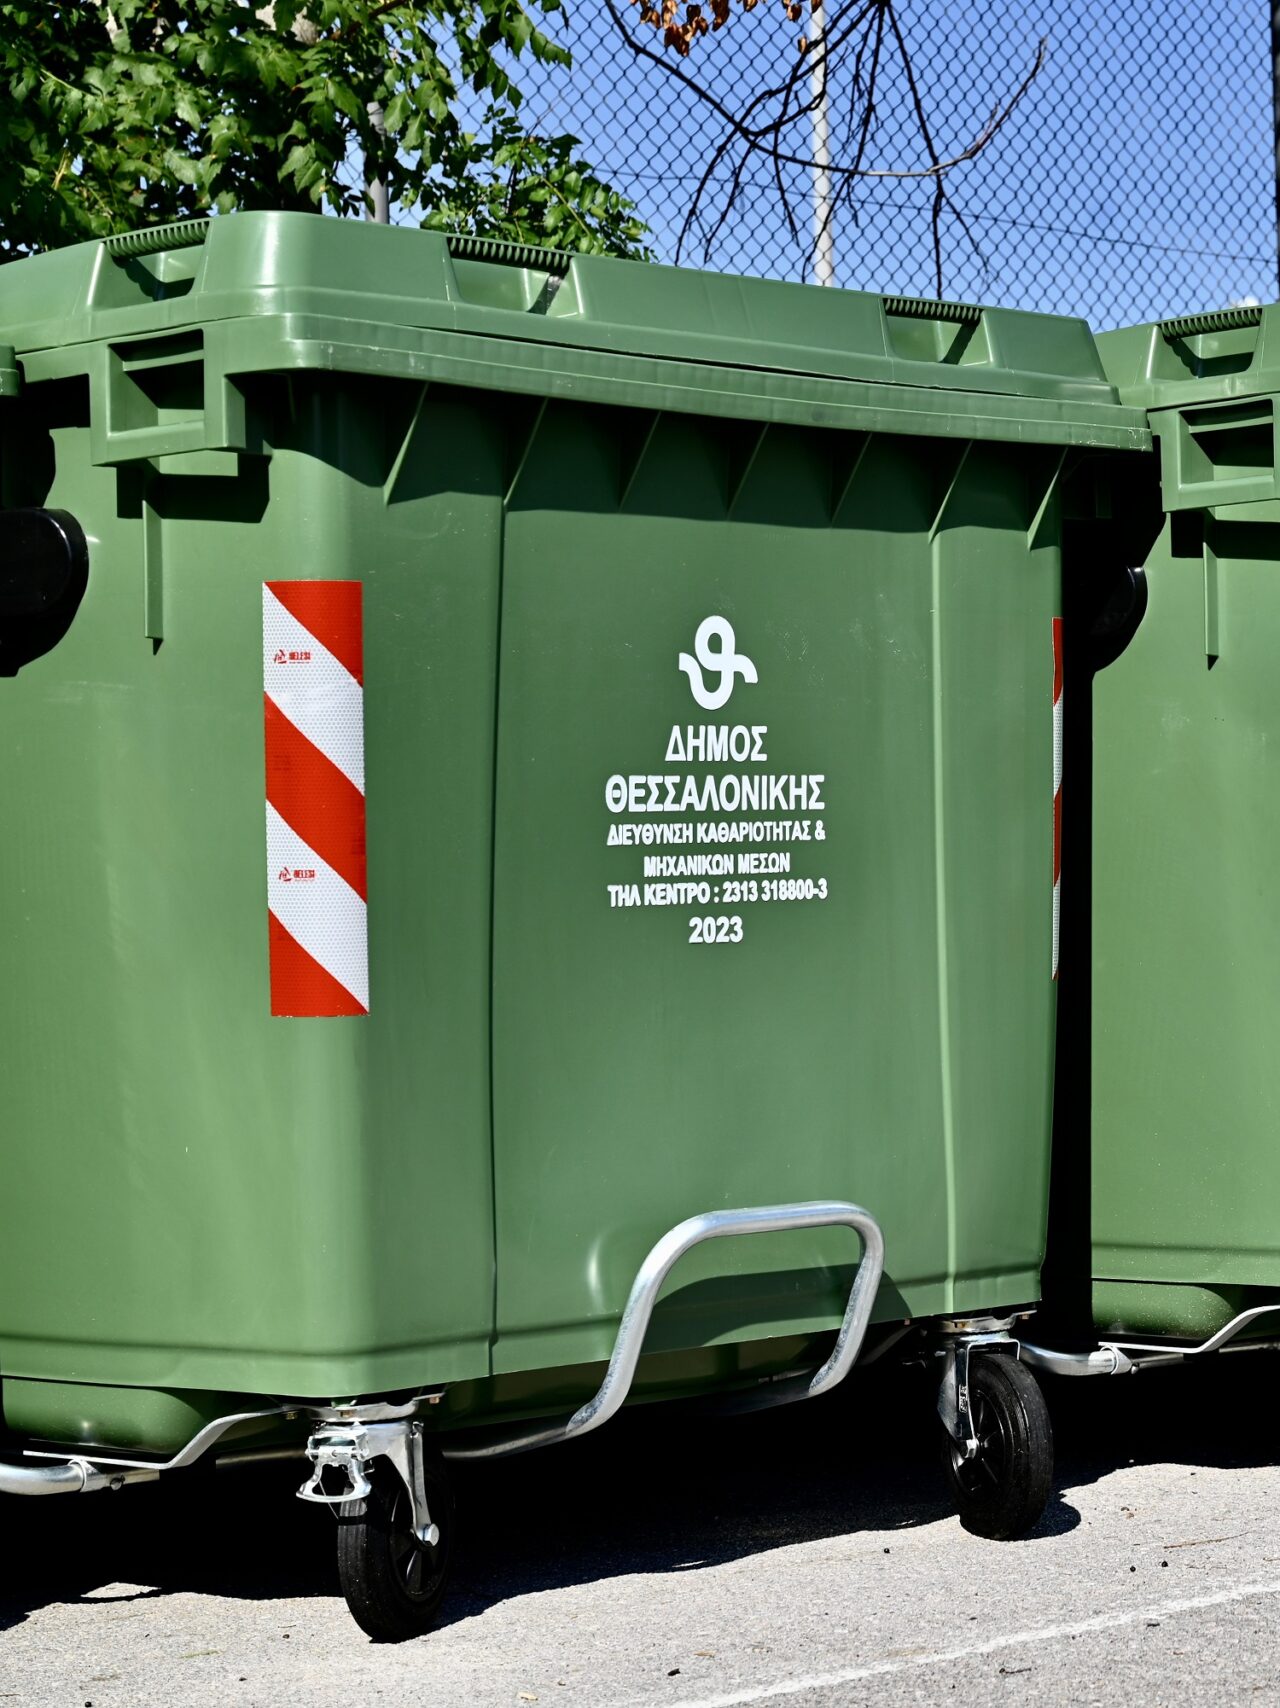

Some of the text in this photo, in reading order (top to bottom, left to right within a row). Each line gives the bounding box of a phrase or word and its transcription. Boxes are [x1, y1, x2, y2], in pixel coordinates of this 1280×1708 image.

[665, 725, 767, 761] ΔΗΜΟΣ
[606, 775, 825, 812] ΘΕΣΣΑΛΟΝΙΚΗΣ
[607, 820, 825, 845] ΔΙΕΥΘΥΝΣΗ ΚΑΘΑΡΙΟΤΗΤΑΣ &
[644, 853, 790, 877] ΜΗΧΑΝΙΚΩΝ ΜΕΣΩΝ
[608, 878, 827, 907] ΤΗΛ ΚΕΝΤΡΟ : 2313 318800-3
[689, 916, 743, 943] 2023
